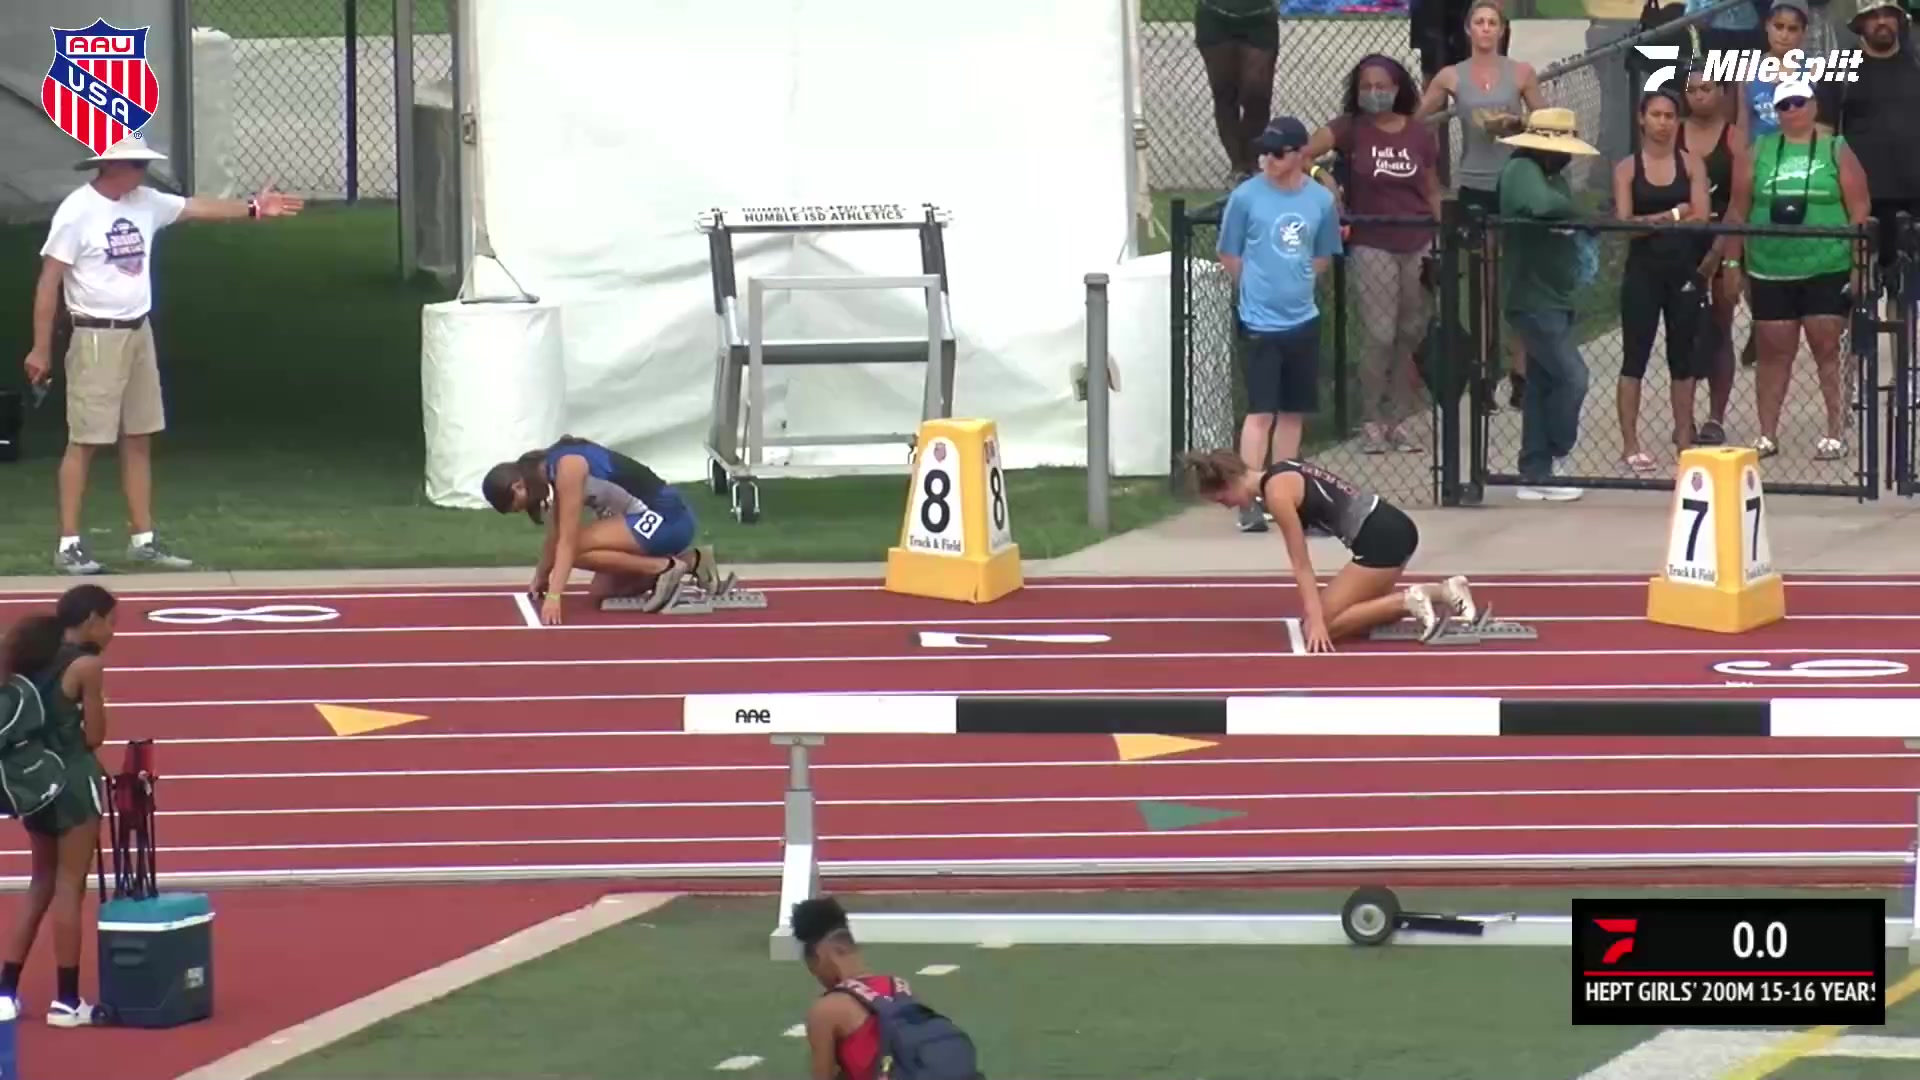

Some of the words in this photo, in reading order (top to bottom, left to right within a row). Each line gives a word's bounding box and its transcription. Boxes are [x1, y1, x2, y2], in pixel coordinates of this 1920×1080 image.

[744, 212, 799, 223] HUMBLE
[804, 211, 825, 222] ISD
[830, 209, 904, 221] ATHLETICS
[921, 469, 951, 533] 8
[990, 466, 1004, 531] 8
[640, 514, 657, 532] 8
[910, 535, 931, 549] Track
[933, 538, 940, 549] &
[942, 538, 961, 552] Field
[1682, 498, 1708, 562] 7
[1745, 496, 1761, 561] 7
[1668, 563, 1689, 577] Track
